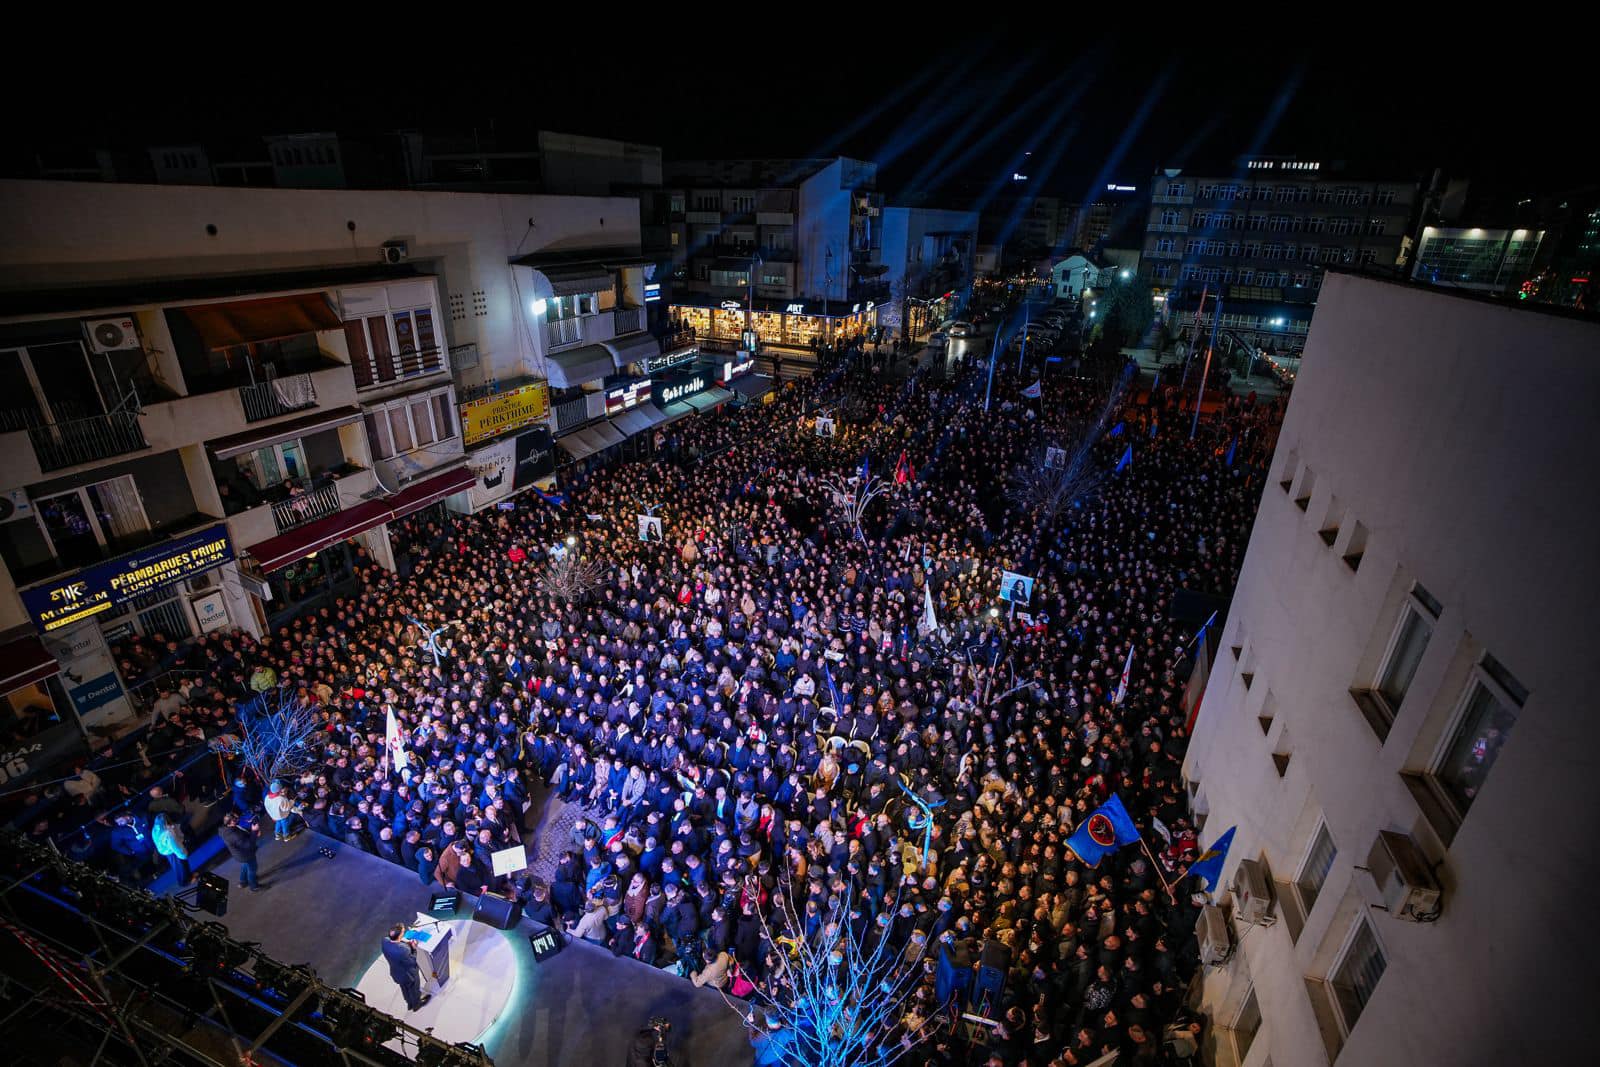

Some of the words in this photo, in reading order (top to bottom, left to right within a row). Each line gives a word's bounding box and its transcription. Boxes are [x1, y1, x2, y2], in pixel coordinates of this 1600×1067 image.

[110, 553, 191, 590] PËRMBARUES
[191, 538, 226, 561] PRIVAT
[122, 569, 181, 595] KUSHTRIM
[200, 610, 226, 625] Dental
[87, 682, 118, 700] Dental
